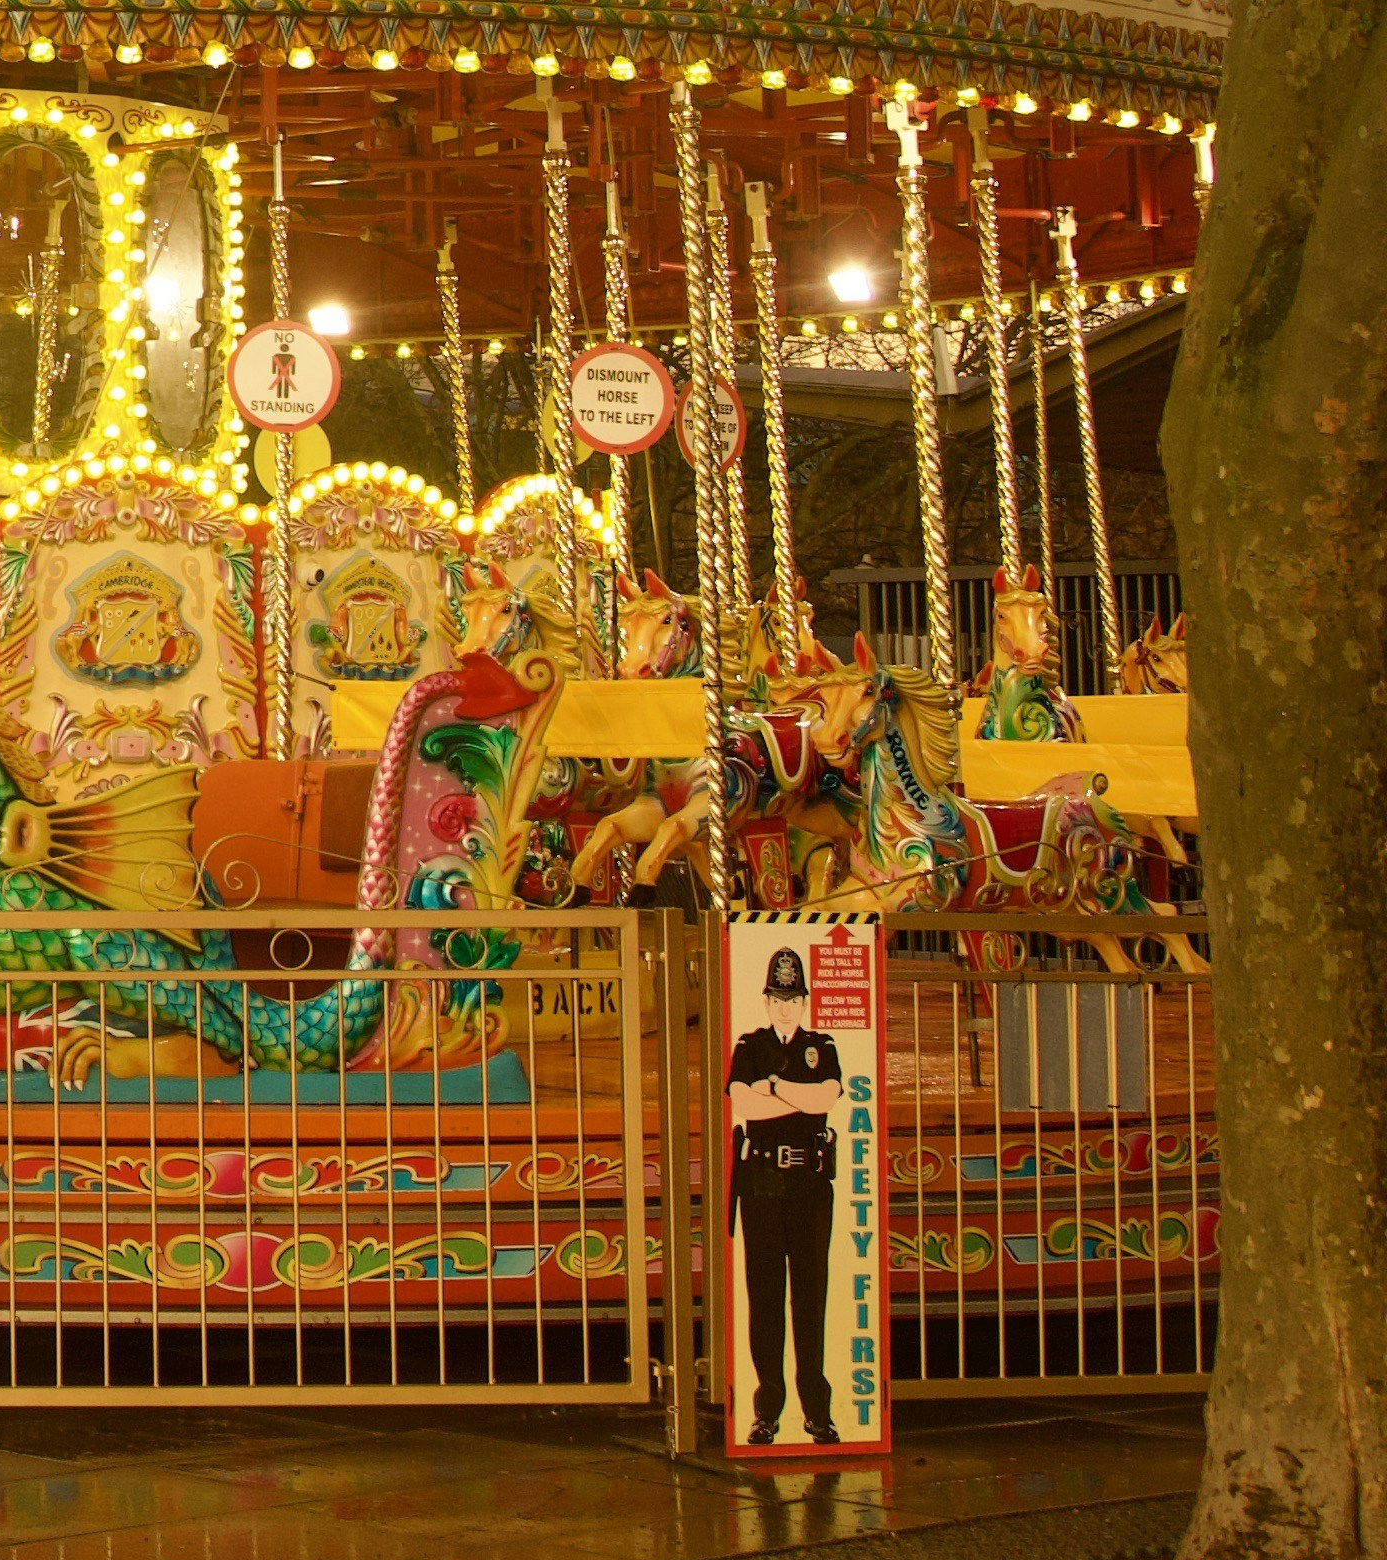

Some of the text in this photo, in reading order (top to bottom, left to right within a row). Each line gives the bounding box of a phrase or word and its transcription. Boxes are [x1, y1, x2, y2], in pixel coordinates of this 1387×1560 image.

[273, 331, 295, 345] NO
[587, 368, 650, 384] DISMOUNT
[597, 389, 638, 404] HORSE
[249, 399, 315, 415] STANDING
[579, 409, 655, 426] TO THE LEFT
[98, 576, 154, 592] CAMBRIDGE
[886, 729, 930, 810] RONNIE
[819, 947, 862, 956] YOU MUST BE
[820, 957, 862, 966] THIS TALL TO
[817, 969, 864, 978] RIDE A HORSE
[812, 980, 869, 988] UNACCOMPANIED
[532, 981, 617, 1016] BACK
[821, 996, 861, 1005] BELOW THIS
[817, 1008, 865, 1016] LINE CAN RIDE
[817, 1019, 866, 1028] IN A CARRIAGE
[847, 1075, 876, 1426] SAFETY FIRST
